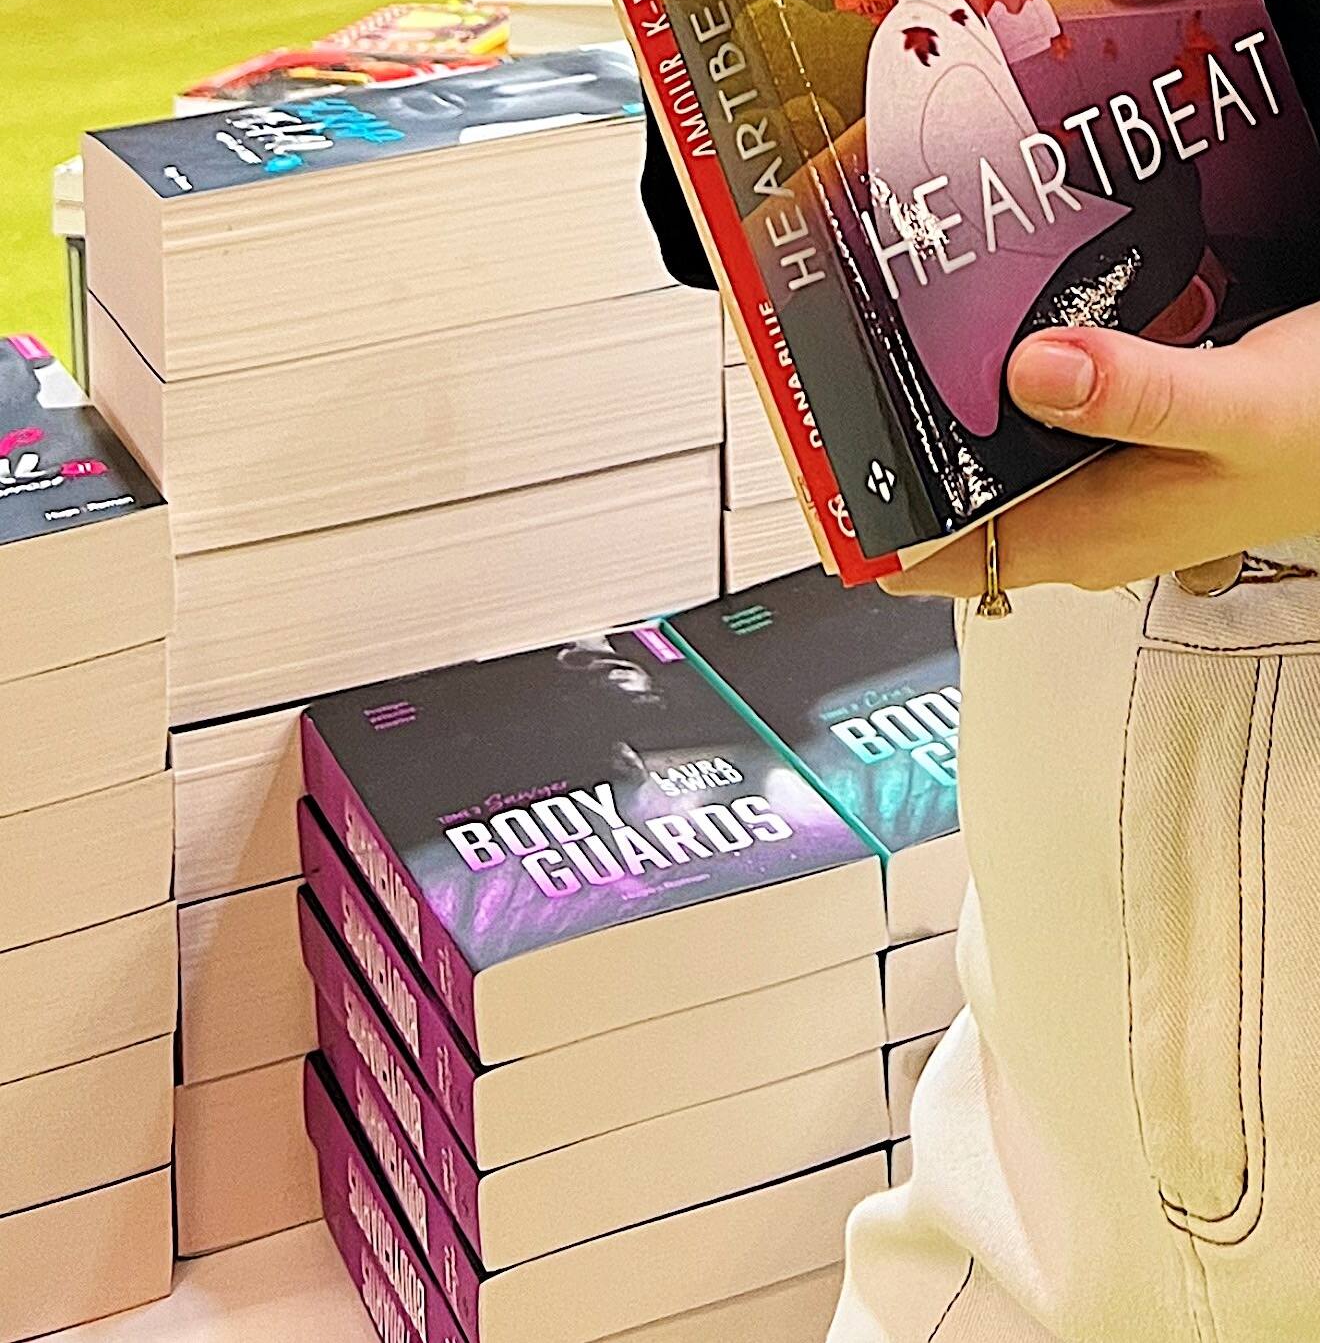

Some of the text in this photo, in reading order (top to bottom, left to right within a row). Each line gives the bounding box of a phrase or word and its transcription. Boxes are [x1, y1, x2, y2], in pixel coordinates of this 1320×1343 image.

[860, 30, 1280, 301] HEARTBEAT
[649, 756, 735, 787] LAURA
[445, 783, 626, 873] BODY
[521, 794, 794, 900] GUARDS
